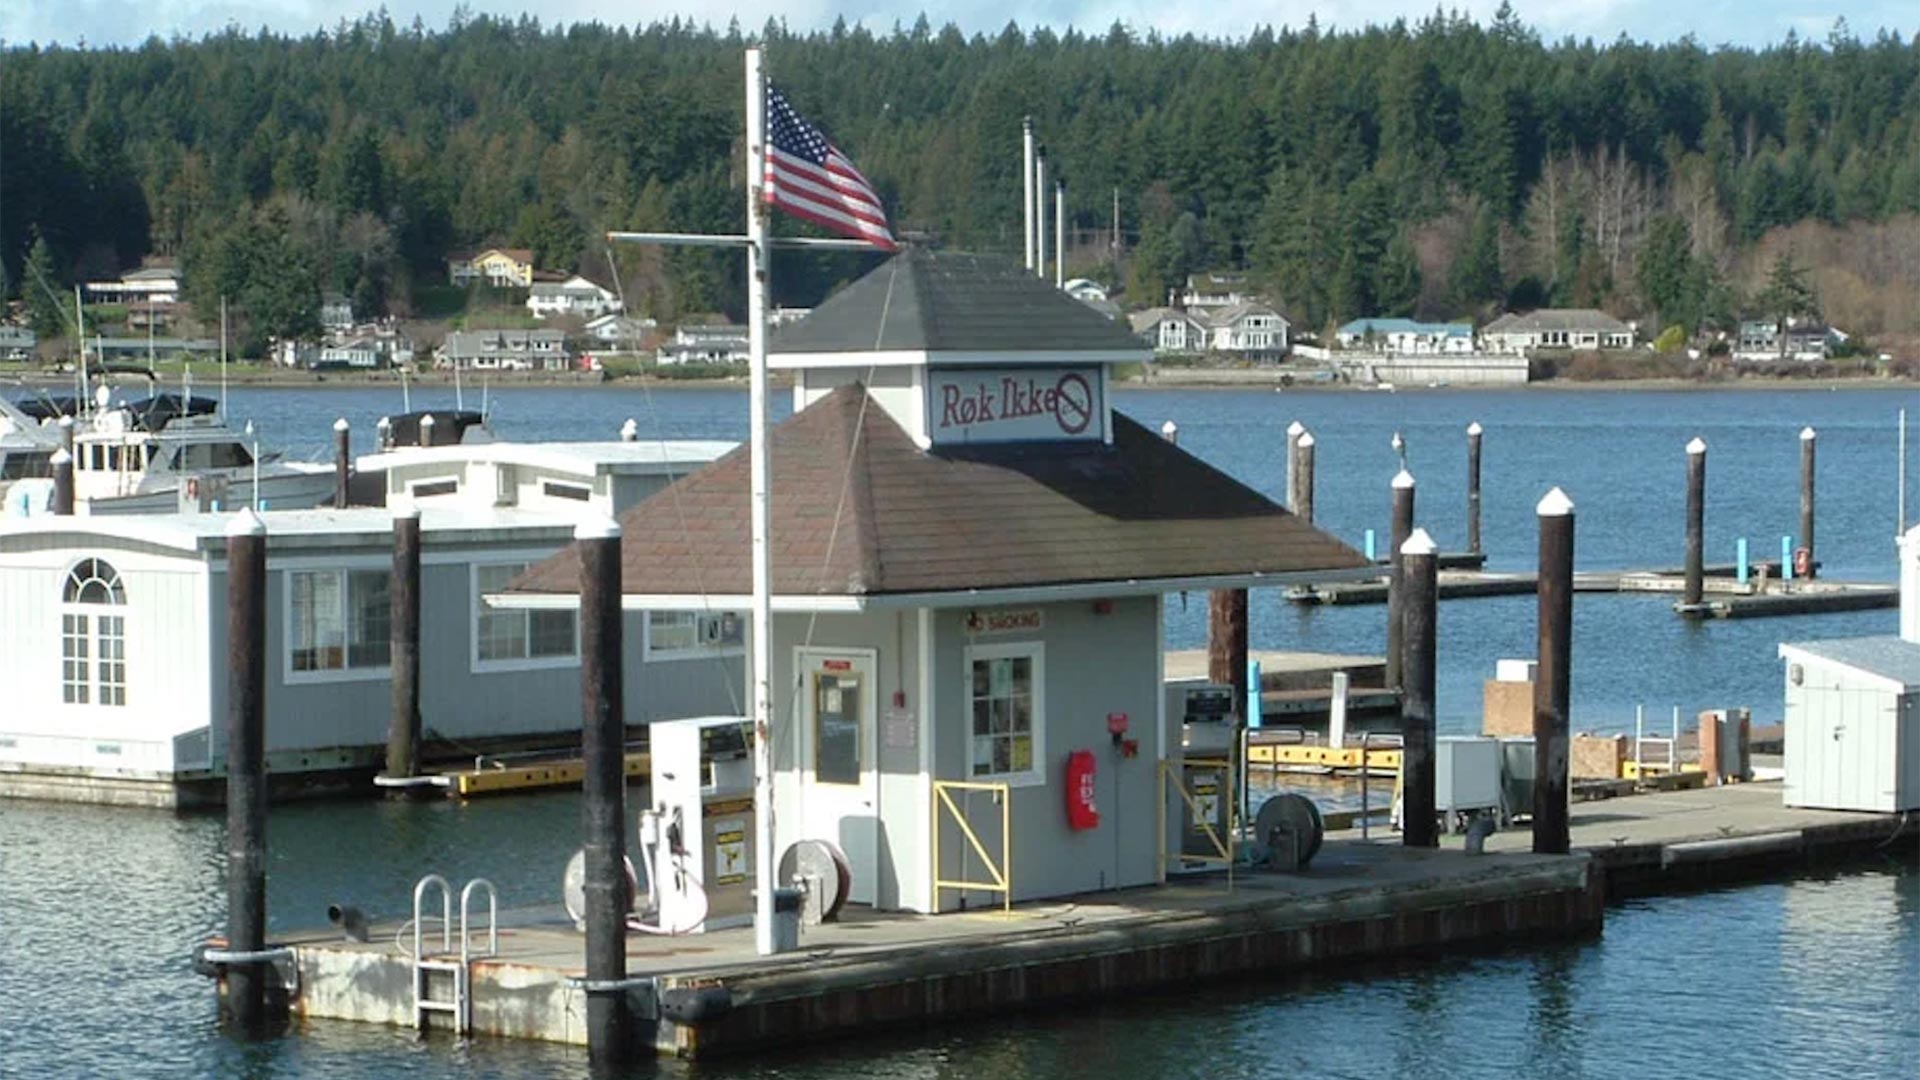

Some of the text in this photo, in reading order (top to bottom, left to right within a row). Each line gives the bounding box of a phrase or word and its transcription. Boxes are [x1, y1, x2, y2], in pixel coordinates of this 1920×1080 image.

[941, 376, 1057, 427] Røk Ikke
[988, 612, 1040, 630] SMOKING
